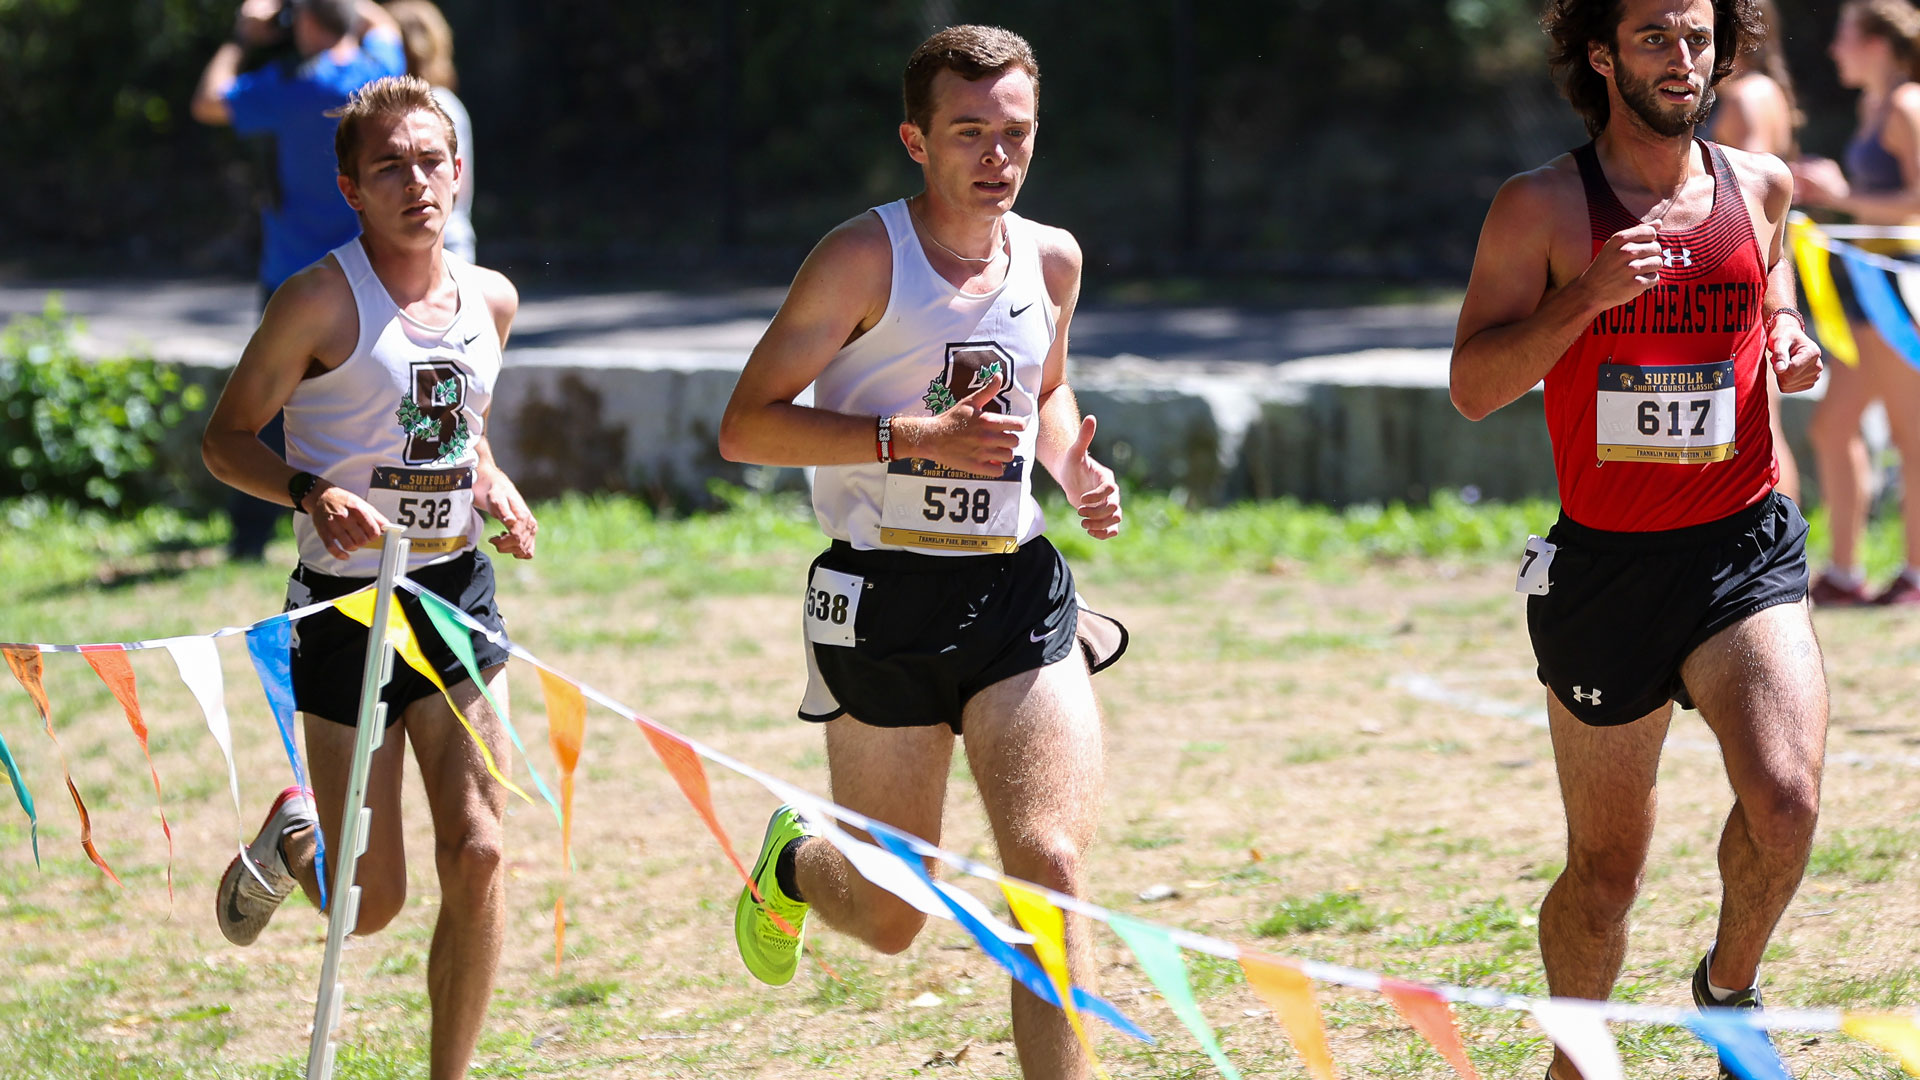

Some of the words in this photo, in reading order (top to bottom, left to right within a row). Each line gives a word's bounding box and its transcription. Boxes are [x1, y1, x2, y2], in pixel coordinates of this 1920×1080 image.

[1633, 384, 1657, 392] SHORT
[1659, 384, 1686, 392] COURSE
[1687, 383, 1714, 391] CLASSIC
[1644, 371, 1704, 385] SUFFOLK
[1637, 399, 1711, 437] 617
[409, 474, 452, 486] SUFFOLK
[397, 497, 452, 530] 532
[922, 485, 991, 524] 538
[807, 586, 850, 626] 538
